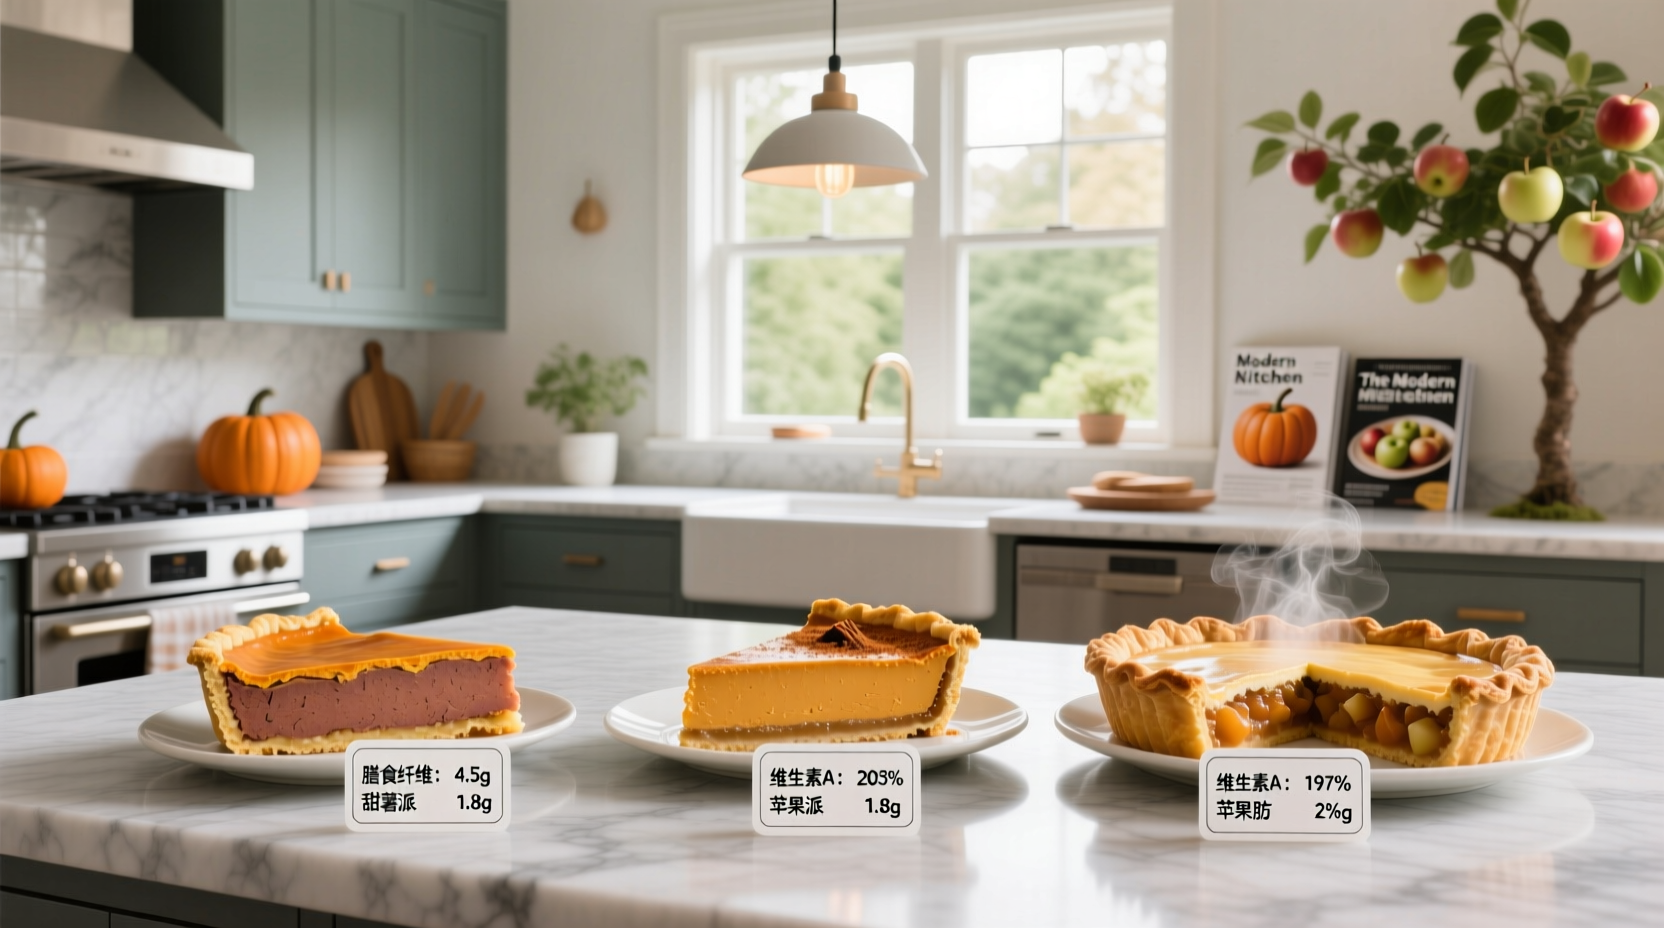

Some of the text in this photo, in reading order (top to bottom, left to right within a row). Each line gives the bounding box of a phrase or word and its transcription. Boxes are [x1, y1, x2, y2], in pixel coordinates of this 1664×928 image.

[1357, 371, 1391, 388] The
[454, 765, 491, 788] 4.5g
[856, 769, 904, 787] 203%
[1305, 774, 1352, 792] 197%
[361, 791, 492, 815] 甜薯派 1.8g
[769, 794, 901, 819] 苹果派 1.8g
[1314, 802, 1353, 825] 2%g
